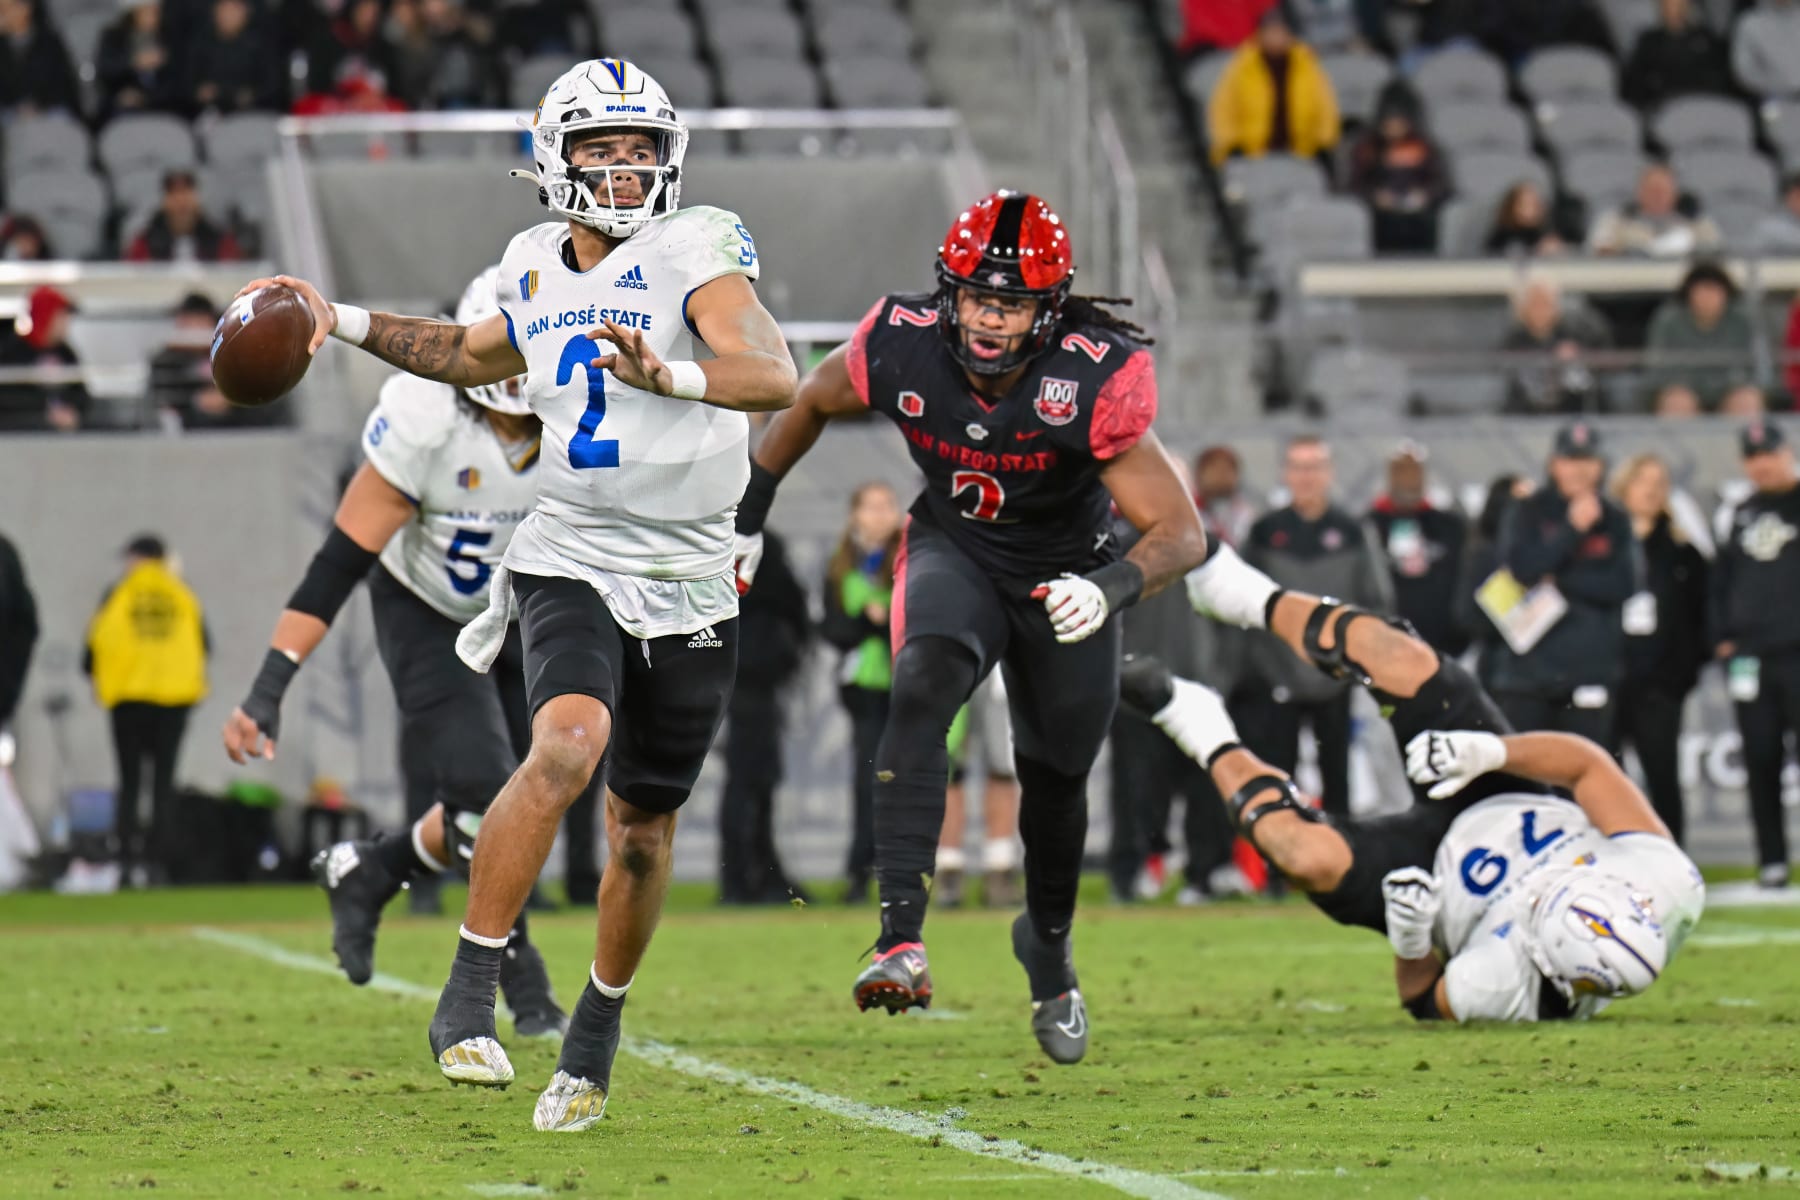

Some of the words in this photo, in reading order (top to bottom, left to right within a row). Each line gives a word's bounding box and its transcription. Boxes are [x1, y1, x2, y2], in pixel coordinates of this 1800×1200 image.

[605, 105, 646, 113] SPARTANS
[614, 279, 648, 291] adidas
[526, 316, 549, 340] SAN
[553, 304, 595, 328] JOSÉ
[599, 308, 652, 331] STATE
[888, 304, 938, 327] 2
[1061, 333, 1111, 363] 2
[556, 333, 620, 469] 2
[1044, 382, 1072, 403] 100
[938, 440, 997, 471] DIEGO
[444, 528, 493, 595] 5
[688, 639, 723, 649] adidas
